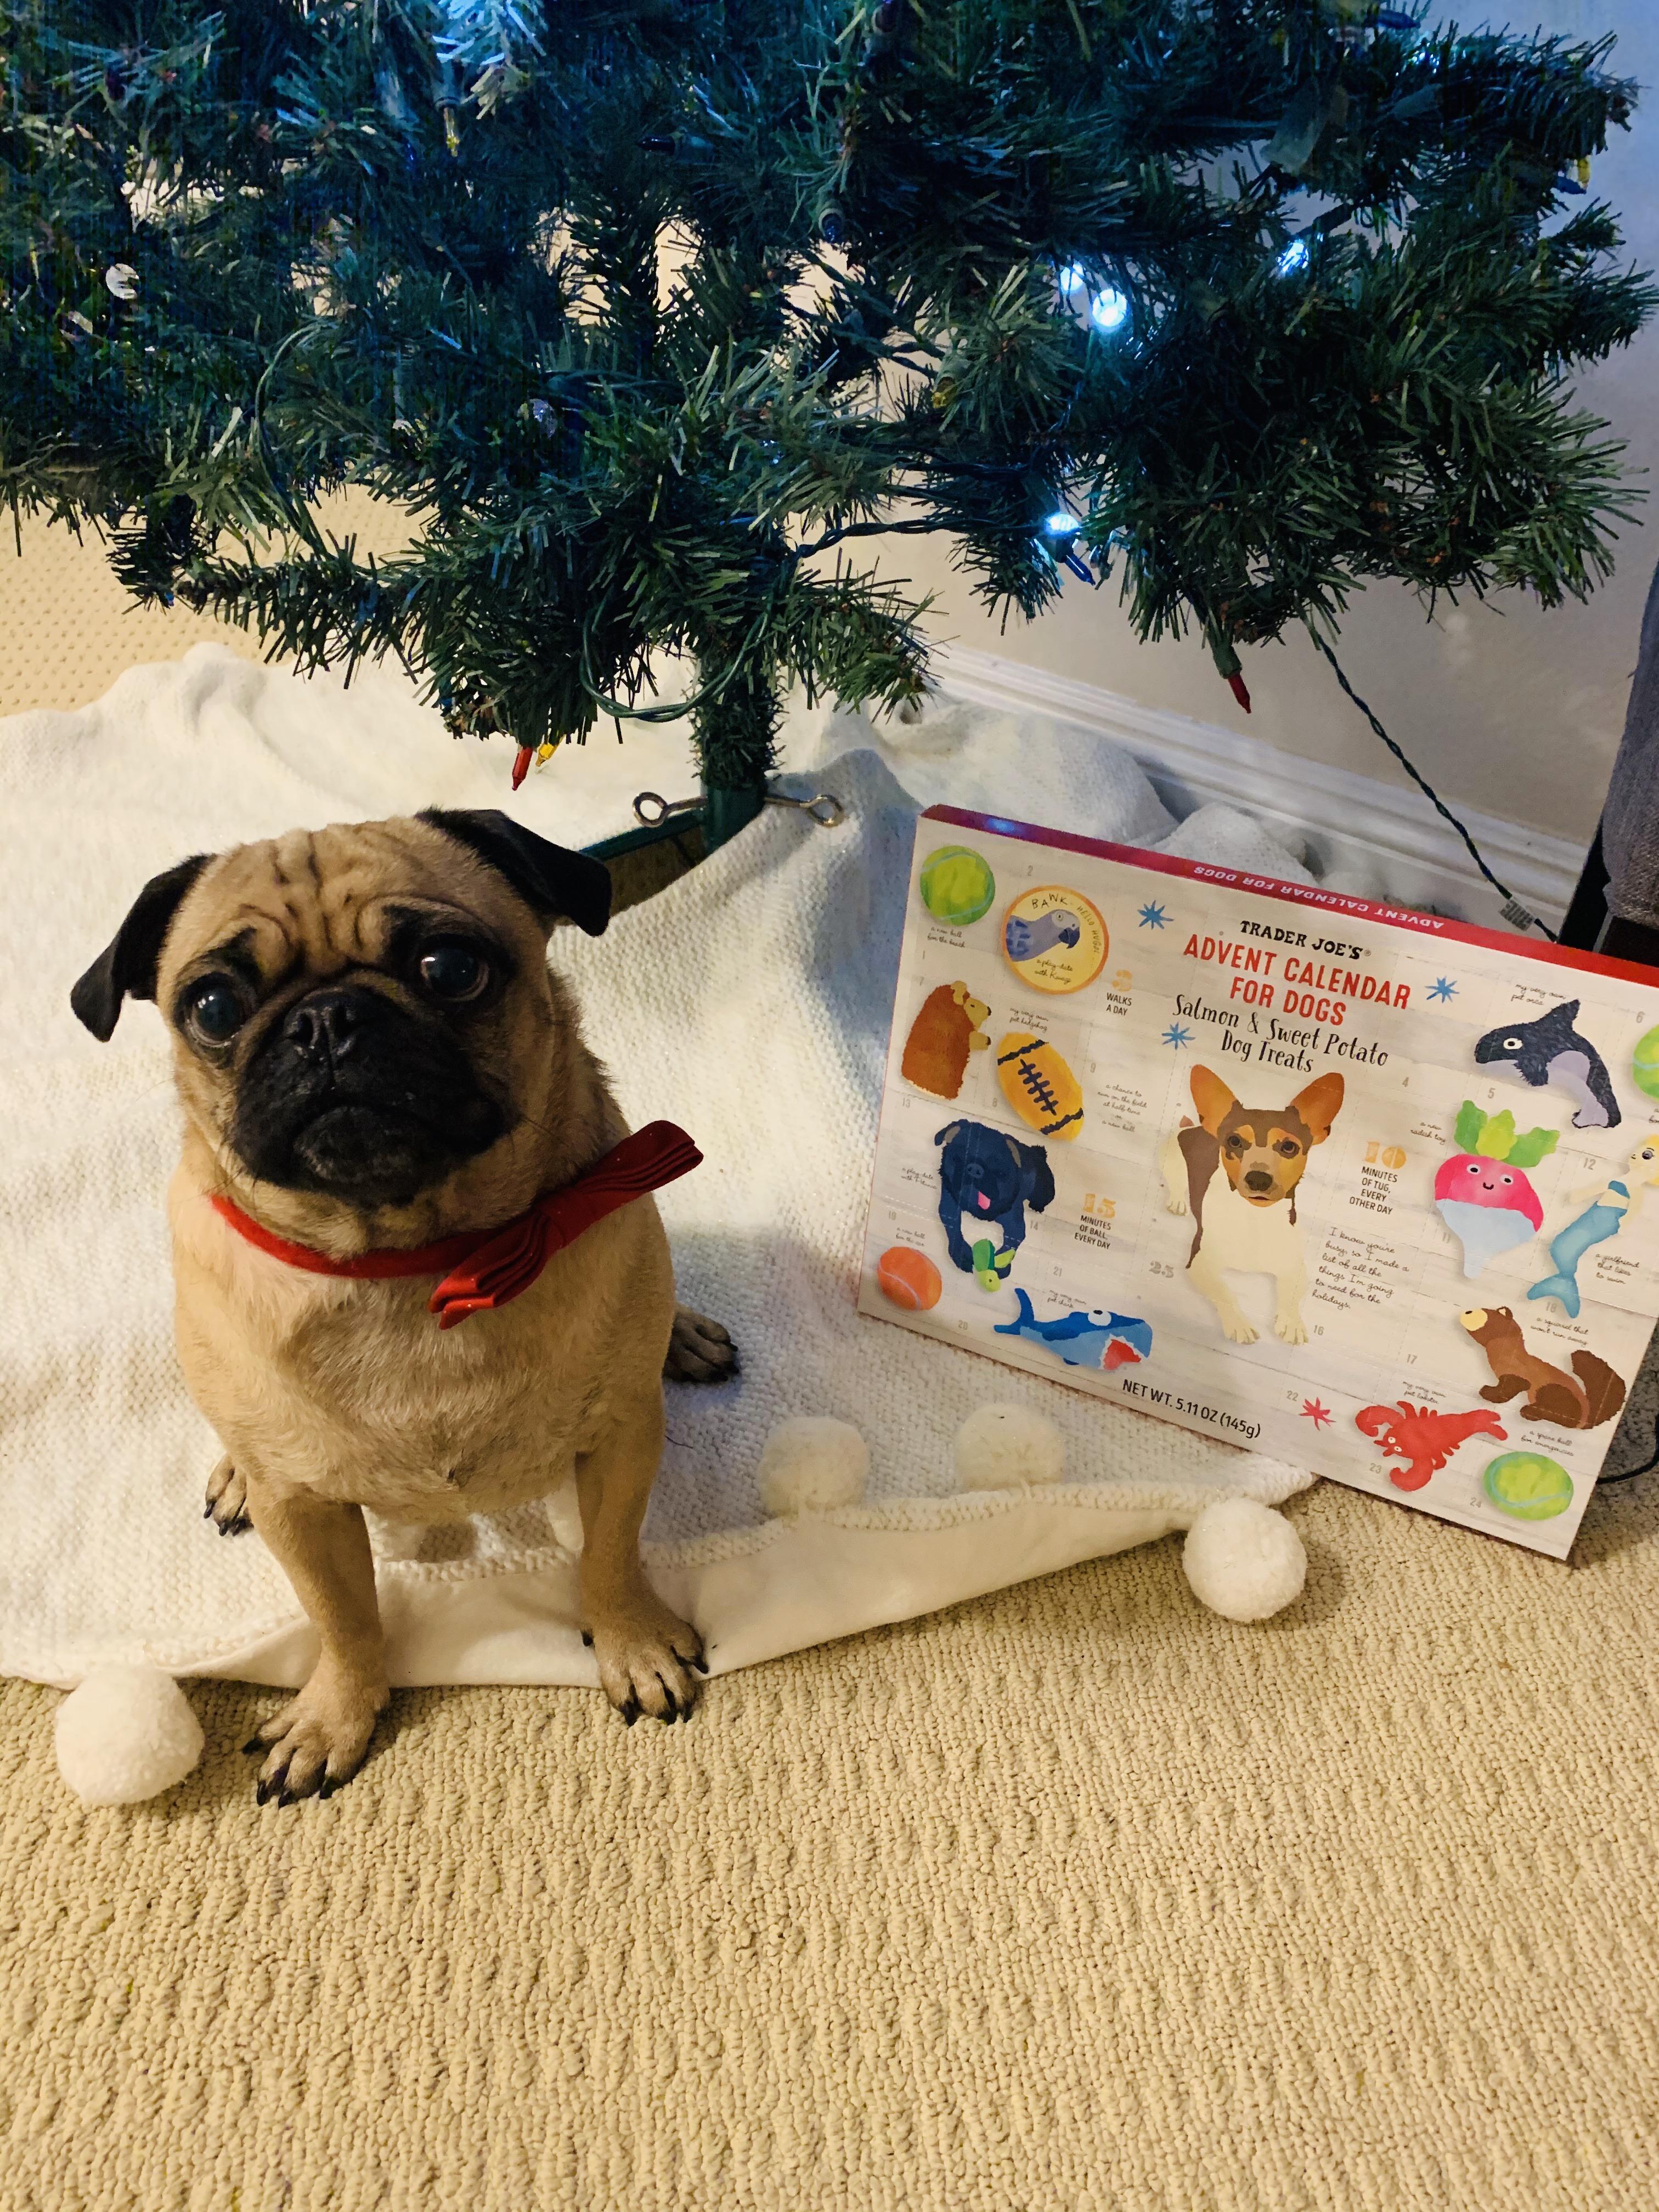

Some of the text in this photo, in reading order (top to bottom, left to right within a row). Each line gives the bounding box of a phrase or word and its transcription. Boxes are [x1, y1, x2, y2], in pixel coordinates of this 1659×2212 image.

[1027, 865, 1034, 877] 2
[1193, 866, 1444, 929] ADVENT CALENDAR FOR DOGS
[1076, 906, 1094, 926] HELLO
[1240, 920, 1307, 948] TRADER
[1183, 933, 1411, 1010] ADVENT CALENDAR
[1111, 969, 1133, 992] 3
[1107, 992, 1132, 1006] WALKS
[1515, 984, 1566, 1000] my very own
[1230, 976, 1347, 1026] FOR DOGS
[1510, 993, 1545, 1006] pet orca
[1113, 1006, 1128, 1015] DAY
[1635, 1011, 1645, 1024] 6
[1022, 1017, 1048, 1033] hedgehog
[1172, 994, 1389, 1066] Salmon & Sweet Potato
[1221, 1029, 1314, 1073] Dog Treats
[1090, 1063, 1096, 1073] 9
[1402, 1076, 1409, 1087] 4
[1112, 1085, 1133, 1094] chance
[1487, 1087, 1496, 1098] 5
[902, 1098, 910, 1108] 13
[992, 1098, 997, 1107] 8
[1132, 1099, 1147, 1108] field
[1122, 1124, 1135, 1132] ball
[1410, 1129, 1447, 1146] radish toy
[1364, 1141, 1407, 1169] 10
[1583, 1158, 1596, 1170] 12
[1361, 1166, 1398, 1183] MINUTES
[1362, 1177, 1391, 1194] OF TUG,
[1361, 1189, 1387, 1202] EVERY
[1083, 1193, 1116, 1218] 15
[1350, 1197, 1393, 1215] OTHER DAY
[1030, 1220, 1038, 1231] 14
[1080, 1215, 1111, 1230] MINUTES
[1074, 1233, 1110, 1250] EVERY DAY
[1329, 1226, 1395, 1254] I know you're
[1442, 1232, 1451, 1243] 11
[1325, 1240, 1348, 1257] busy,
[1364, 1250, 1373, 1261] I
[1375, 1258, 1400, 1268] made
[1322, 1253, 1382, 1277] list of all the
[1601, 1255, 1640, 1268] girlfriend
[1053, 1266, 1063, 1277] 21
[1319, 1266, 1395, 1298] things I'm going
[1606, 1276, 1626, 1285] swim
[1316, 1278, 1381, 1304] to need for the
[1312, 1289, 1351, 1311] holidays.
[1545, 1301, 1557, 1313] 18
[958, 1320, 968, 1330] 20
[1313, 1325, 1324, 1335] 16
[1545, 1319, 1572, 1331] squirrel
[1573, 1326, 1589, 1335] that
[1530, 1325, 1551, 1335] won't
[1567, 1335, 1588, 1347] away
[1406, 1353, 1418, 1364] 17
[1403, 1380, 1413, 1390] my
[1286, 1390, 1299, 1402] 22
[1122, 1379, 1261, 1439] NET WT. 5.11 OZ (145g)
[1521, 1435, 1574, 1457] for emergencies
[1537, 1432, 1556, 1442] spare
[1557, 1437, 1572, 1446] ball
[1369, 1463, 1382, 1474] 23
